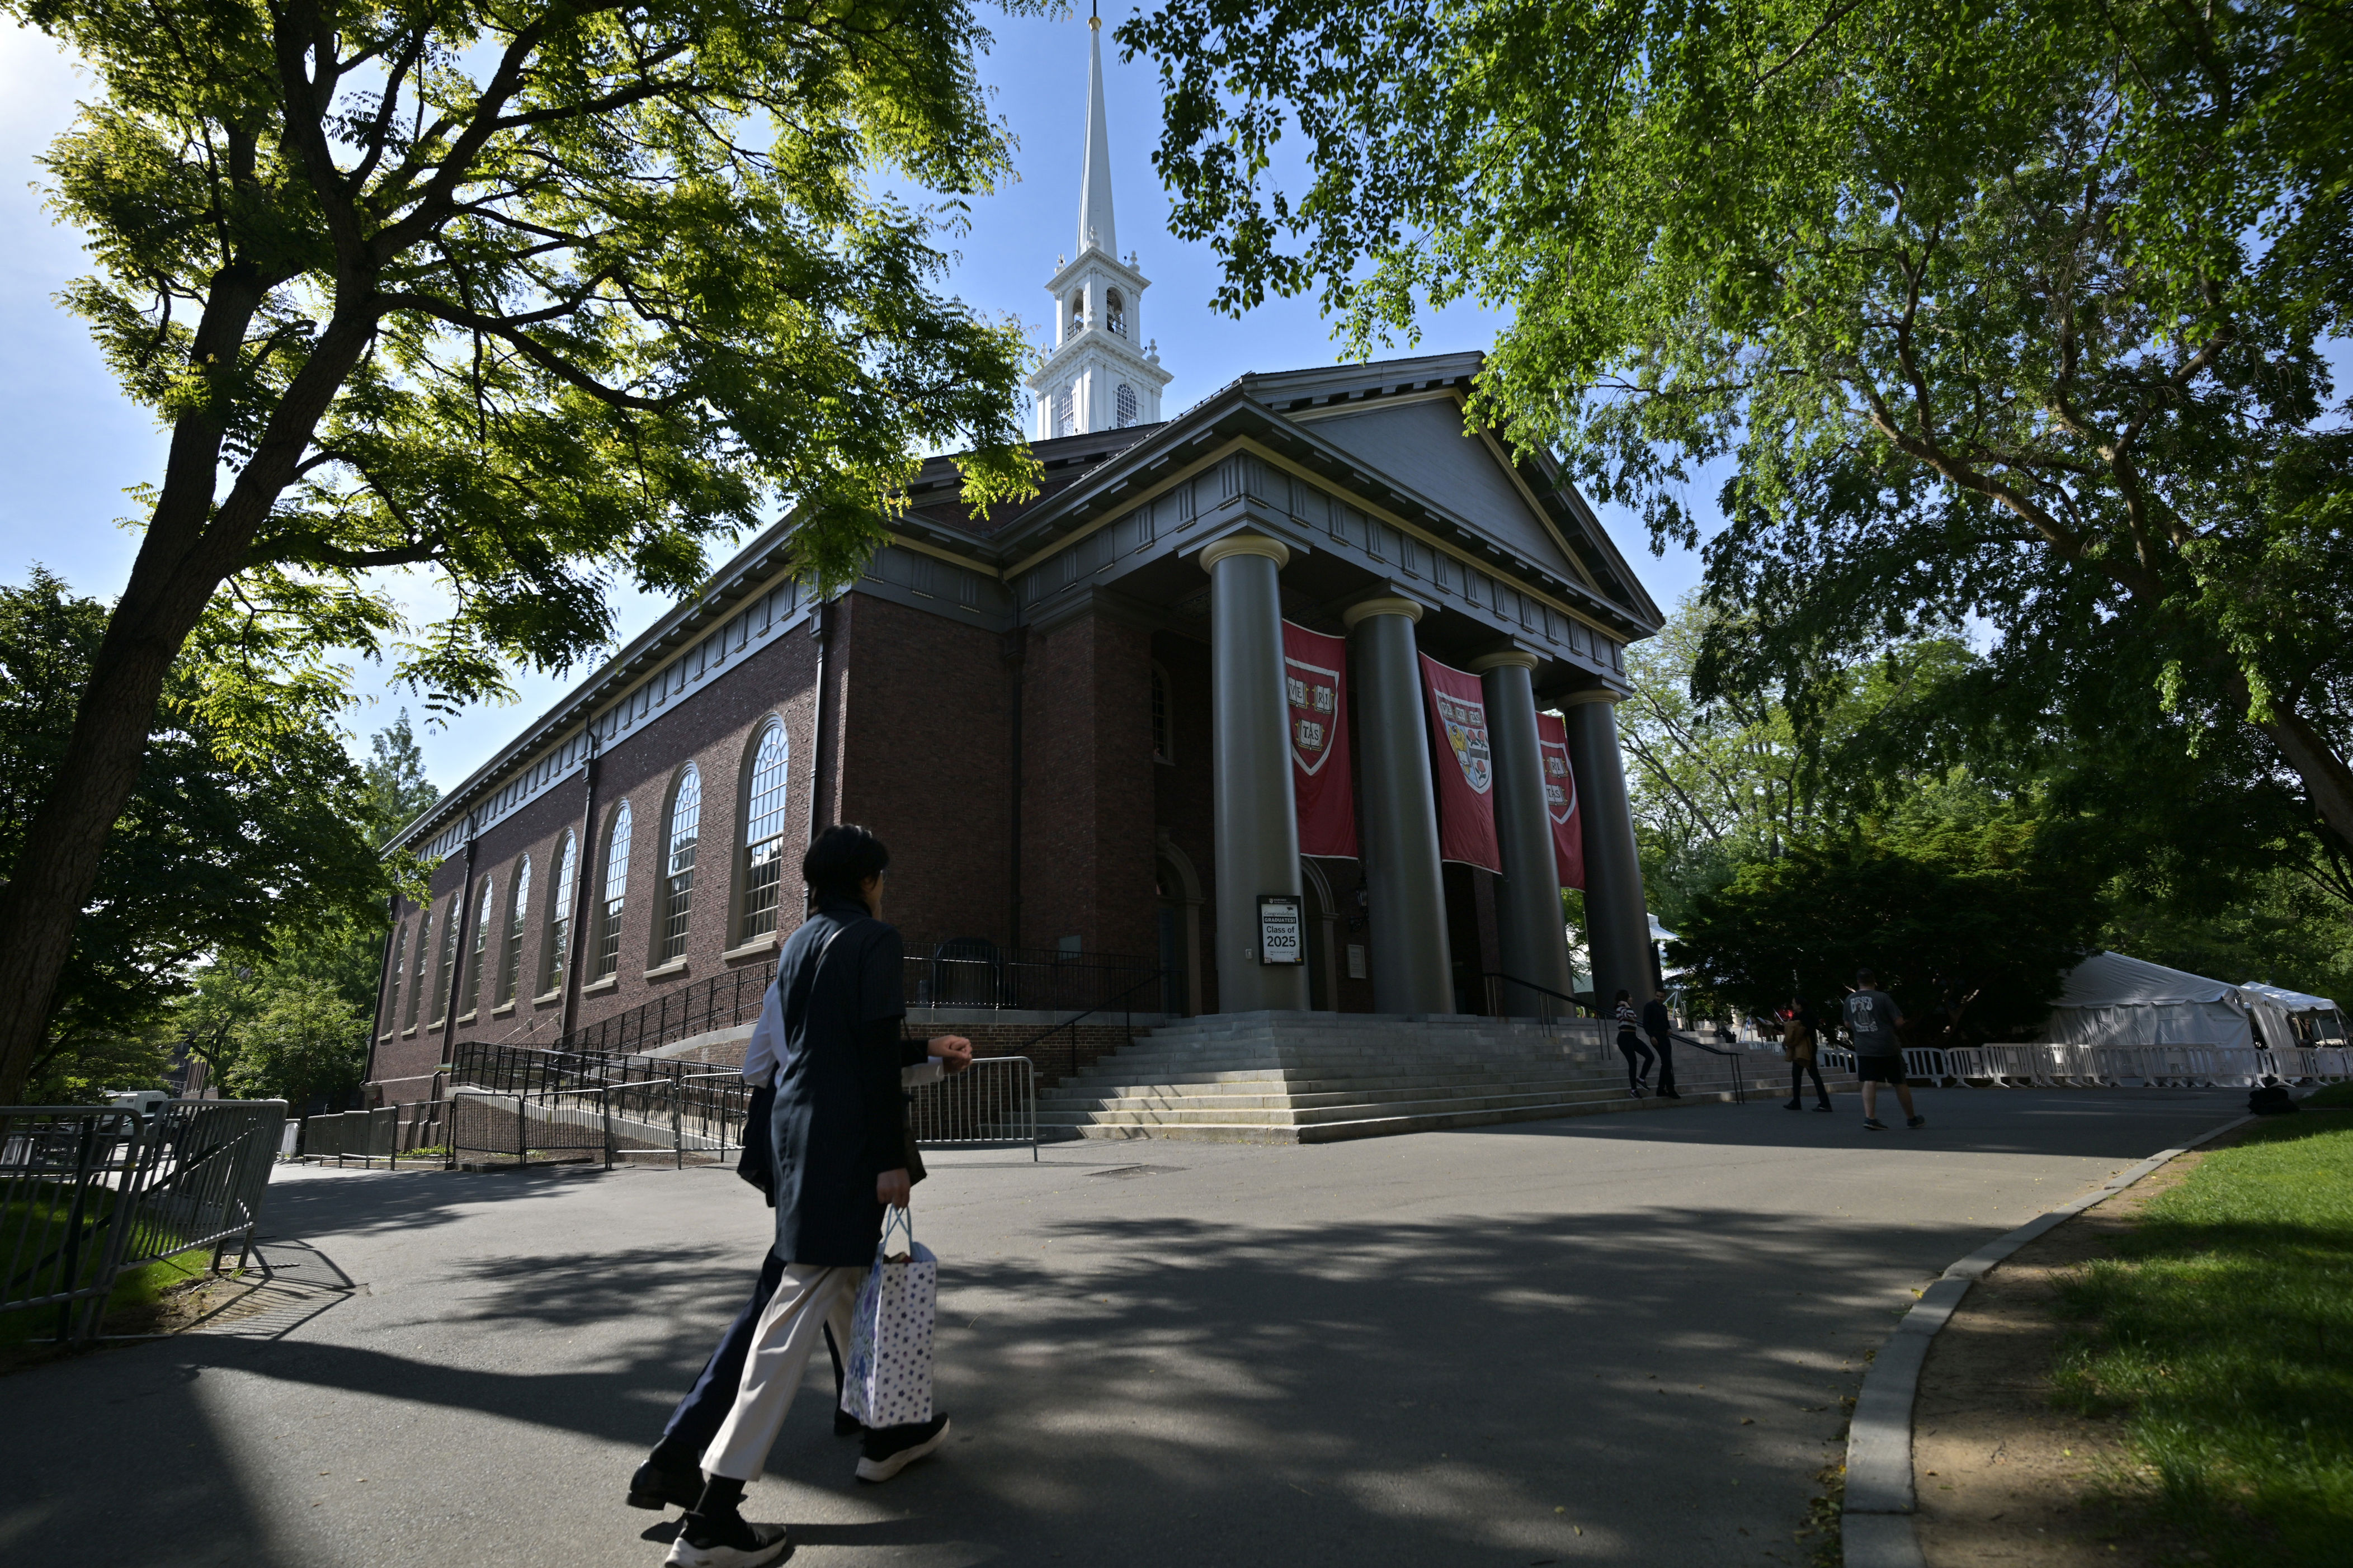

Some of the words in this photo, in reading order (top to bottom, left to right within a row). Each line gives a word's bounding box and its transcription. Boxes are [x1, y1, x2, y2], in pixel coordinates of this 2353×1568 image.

[1289, 683, 1302, 698] VE
[1318, 692, 1328, 705] RI
[1303, 726, 1319, 741] TAS
[1552, 762, 1560, 771] RI
[1546, 788, 1561, 798] TAS
[1267, 936, 1296, 947] 2025
